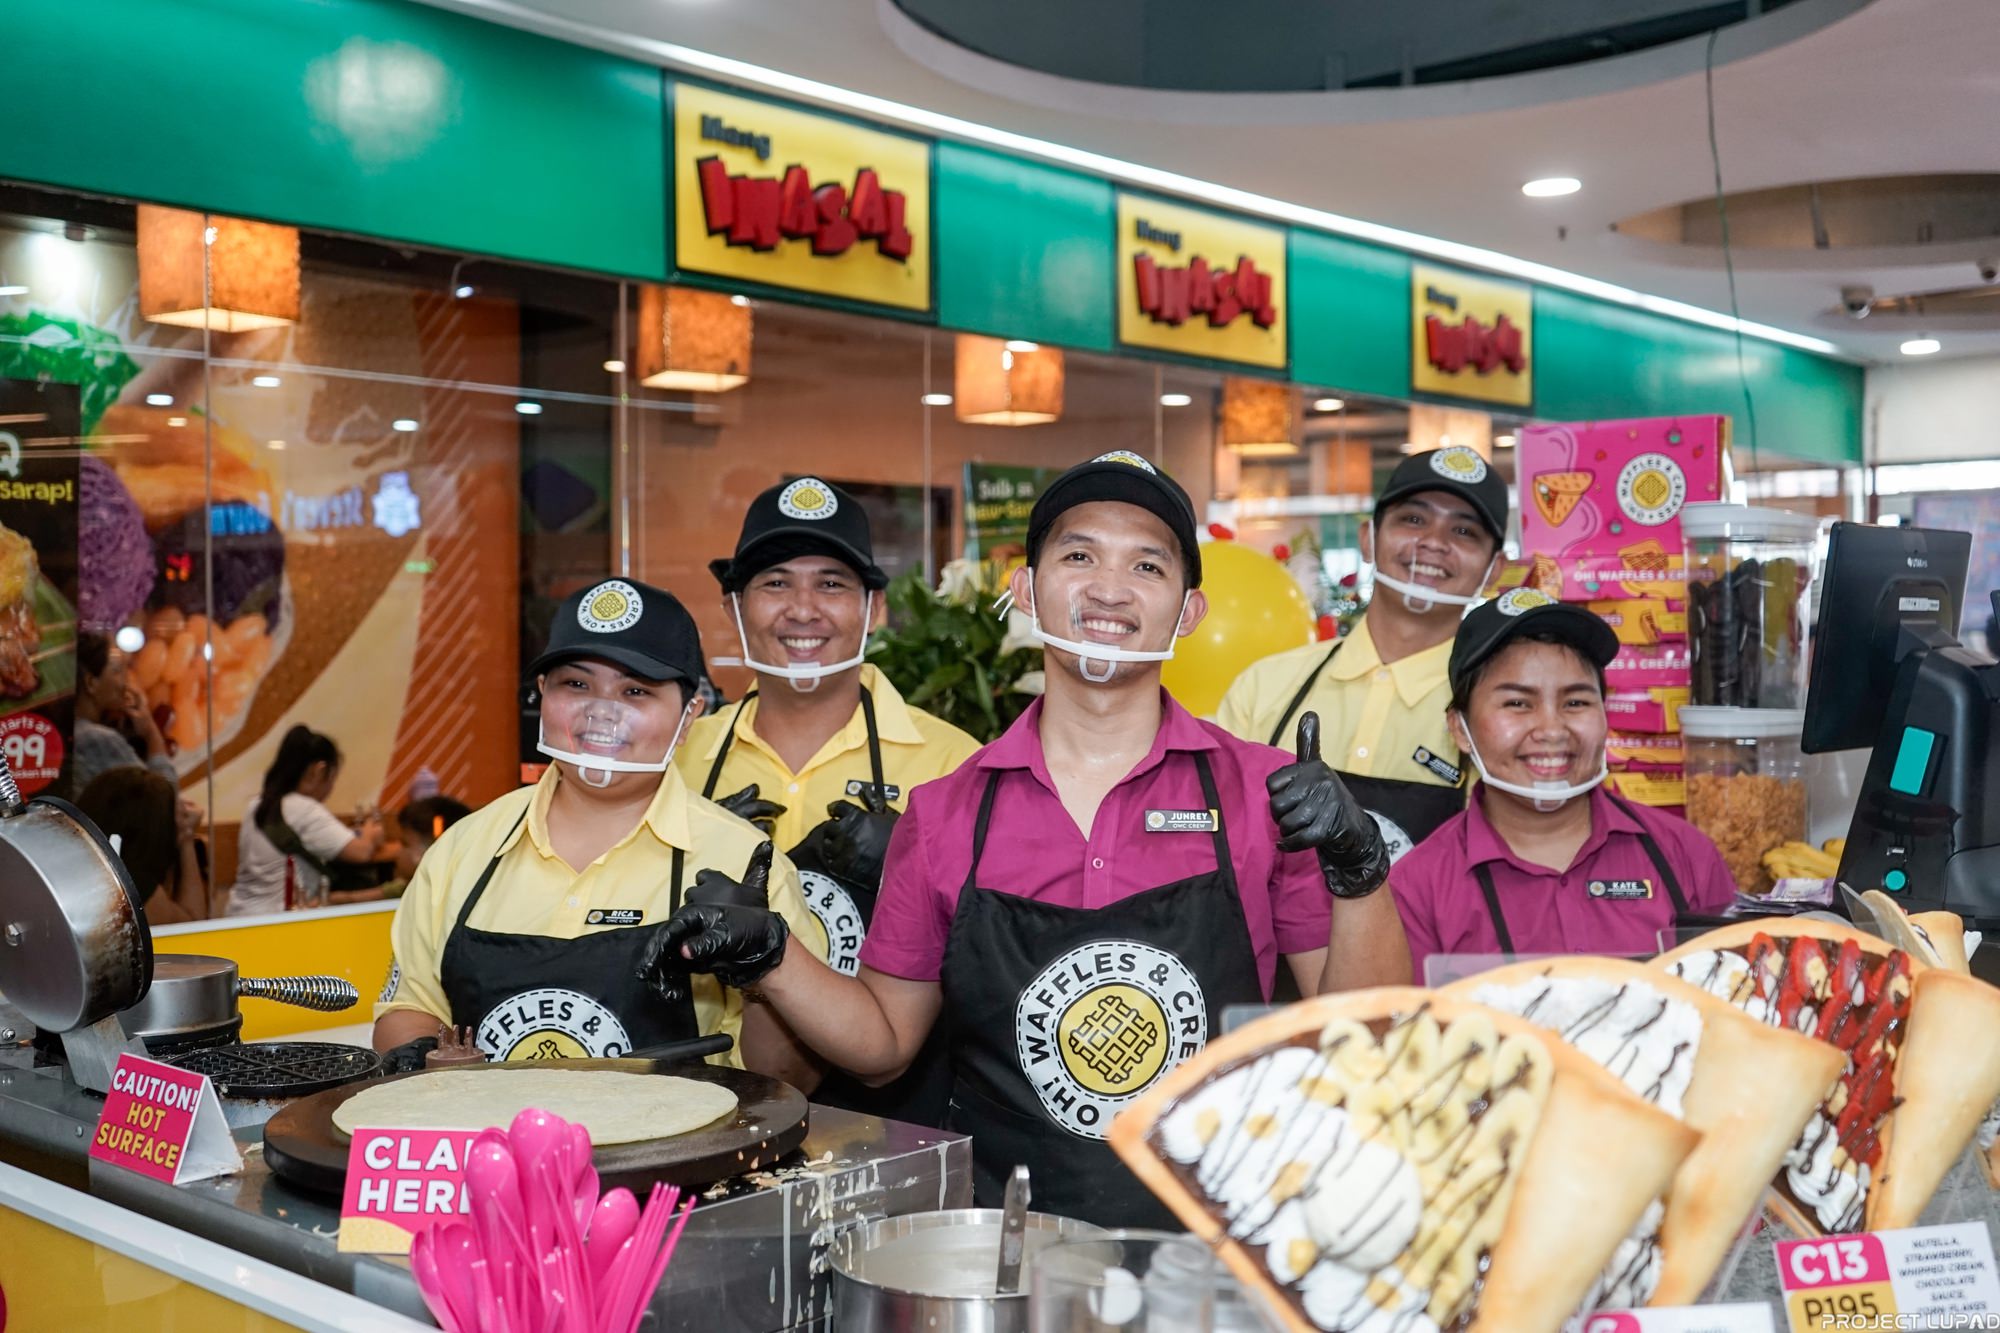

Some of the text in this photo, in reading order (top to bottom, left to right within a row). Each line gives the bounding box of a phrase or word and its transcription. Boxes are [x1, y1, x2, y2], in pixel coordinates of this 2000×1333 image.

[1573, 571, 1596, 582] OH!
[1599, 570, 1654, 582] WAFFLES
[581, 583, 625, 614] WAFFLES
[609, 600, 639, 630] CREPES
[1171, 812, 1208, 820] JUNREY
[1612, 881, 1638, 889] KATE
[820, 892, 857, 972] & CRE
[484, 999, 602, 1062] FFLES &
[1026, 952, 1200, 1126] OH! WAFFLES & CRE
[112, 1068, 199, 1113] CAUTION!
[126, 1101, 167, 1132] HOT
[96, 1122, 180, 1169] SURFACE
[1790, 1240, 1869, 1285] C13
[1803, 1292, 1878, 1327] P195
